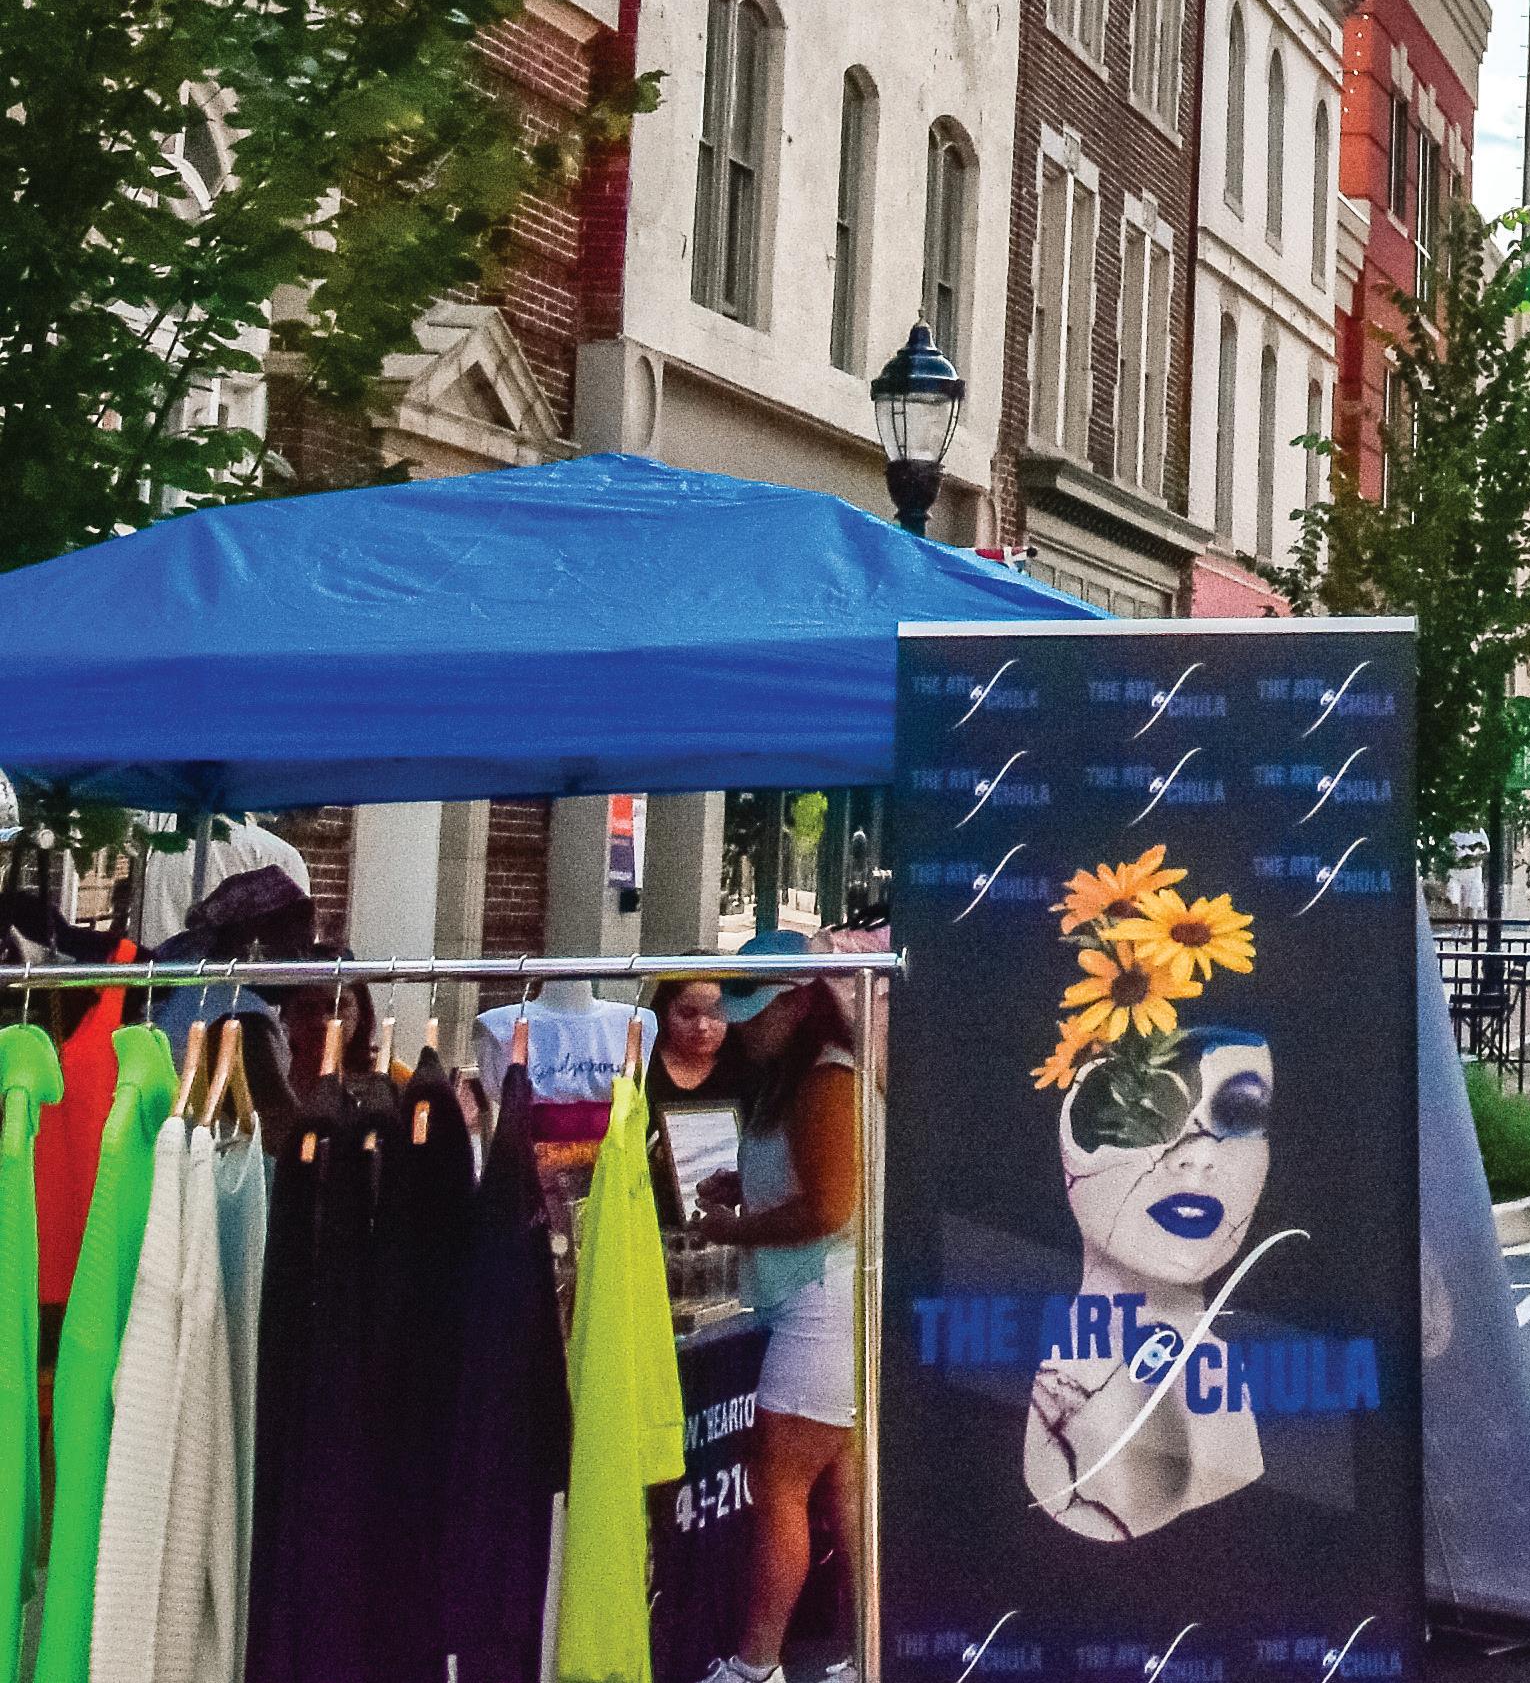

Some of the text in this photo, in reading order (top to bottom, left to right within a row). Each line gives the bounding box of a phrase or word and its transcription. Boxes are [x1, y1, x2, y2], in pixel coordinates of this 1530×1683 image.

[913, 1296, 1022, 1364] THE
[1039, 1292, 1146, 1360] ART
[1186, 1338, 1381, 1414] CHULA
